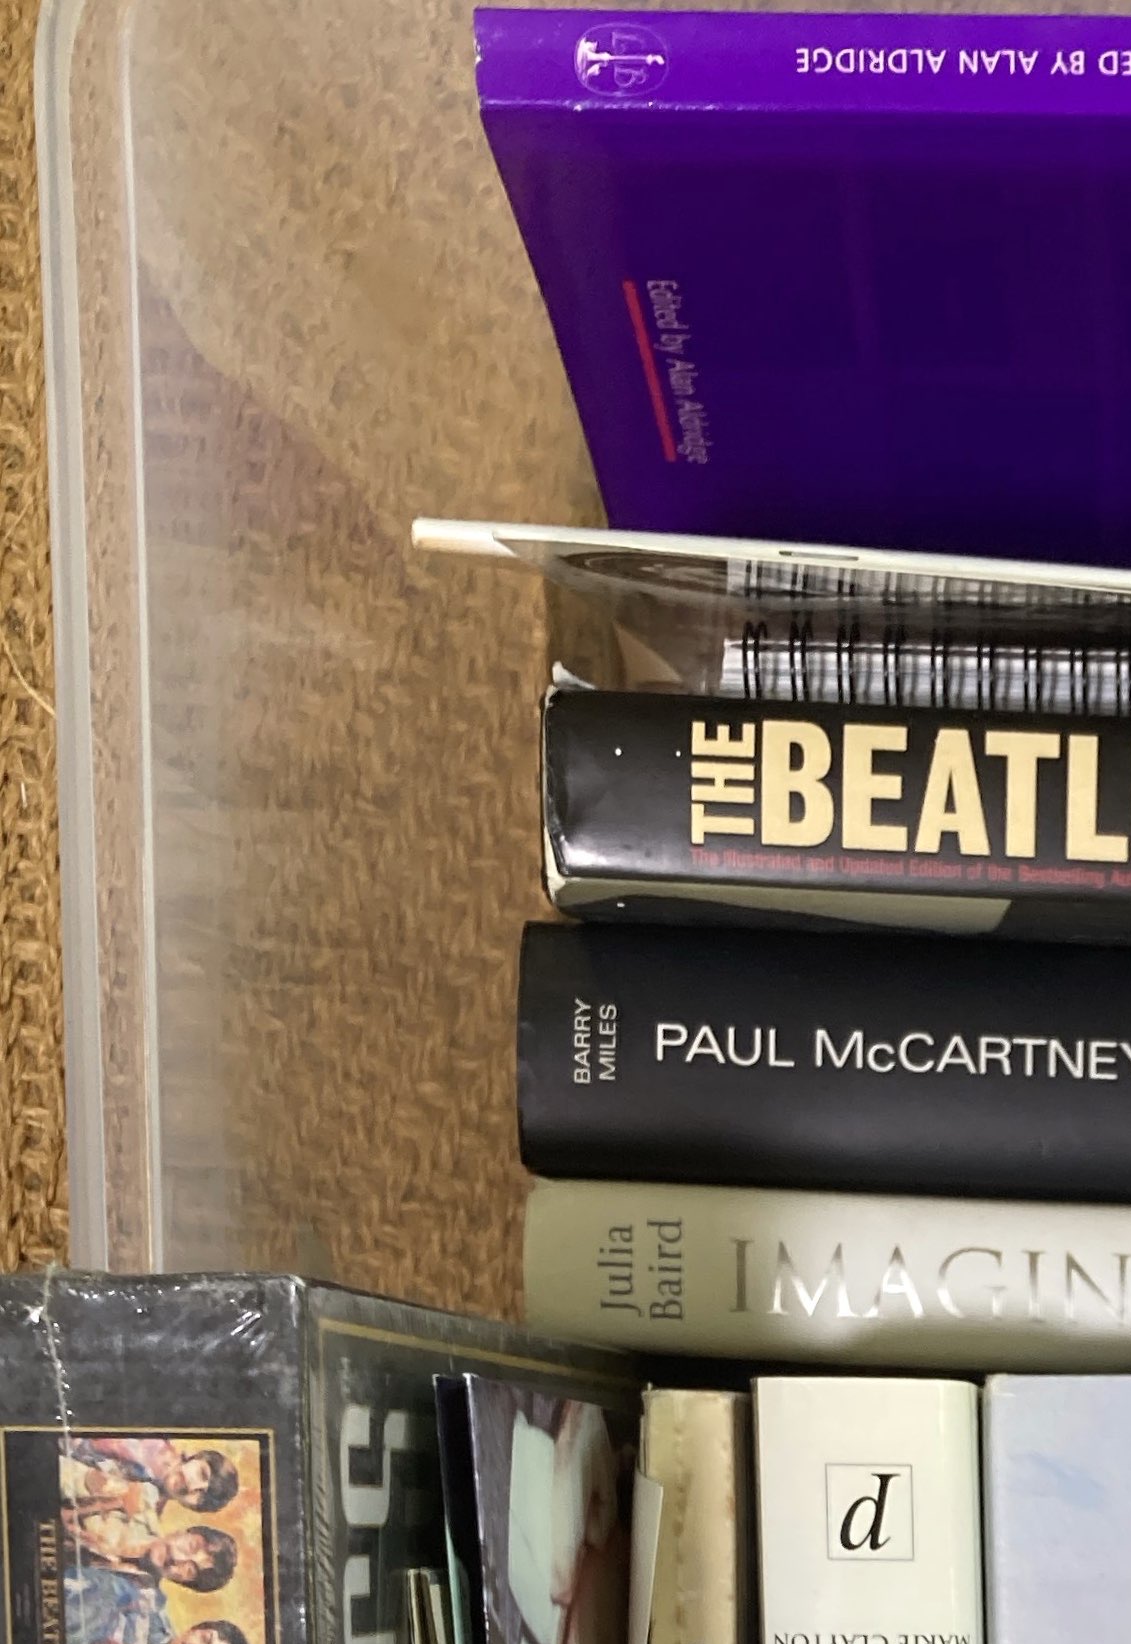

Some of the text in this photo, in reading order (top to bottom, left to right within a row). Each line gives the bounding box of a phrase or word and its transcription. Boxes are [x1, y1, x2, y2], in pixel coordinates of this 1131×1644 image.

[795, 47, 946, 74] ALDRIDGE
[957, 49, 1039, 75] ALAN
[1049, 50, 1085, 75] BY
[647, 280, 713, 464] Edited by Alan Aldridge
[691, 721, 756, 844] THE
[691, 848, 721, 867] The
[724, 850, 800, 873] Illustrated
[807, 855, 833, 872] and
[840, 855, 904, 877] Updated
[909, 858, 961, 879] Edition
[967, 861, 984, 880] of
[988, 863, 1013, 881] the
[571, 997, 593, 1085] BARRY
[598, 1004, 618, 1082] MILES
[654, 1022, 795, 1070] PAUL
[598, 1223, 643, 1317] Julia
[648, 1216, 685, 1322] Baird
[39, 1518, 58, 1572] THE
